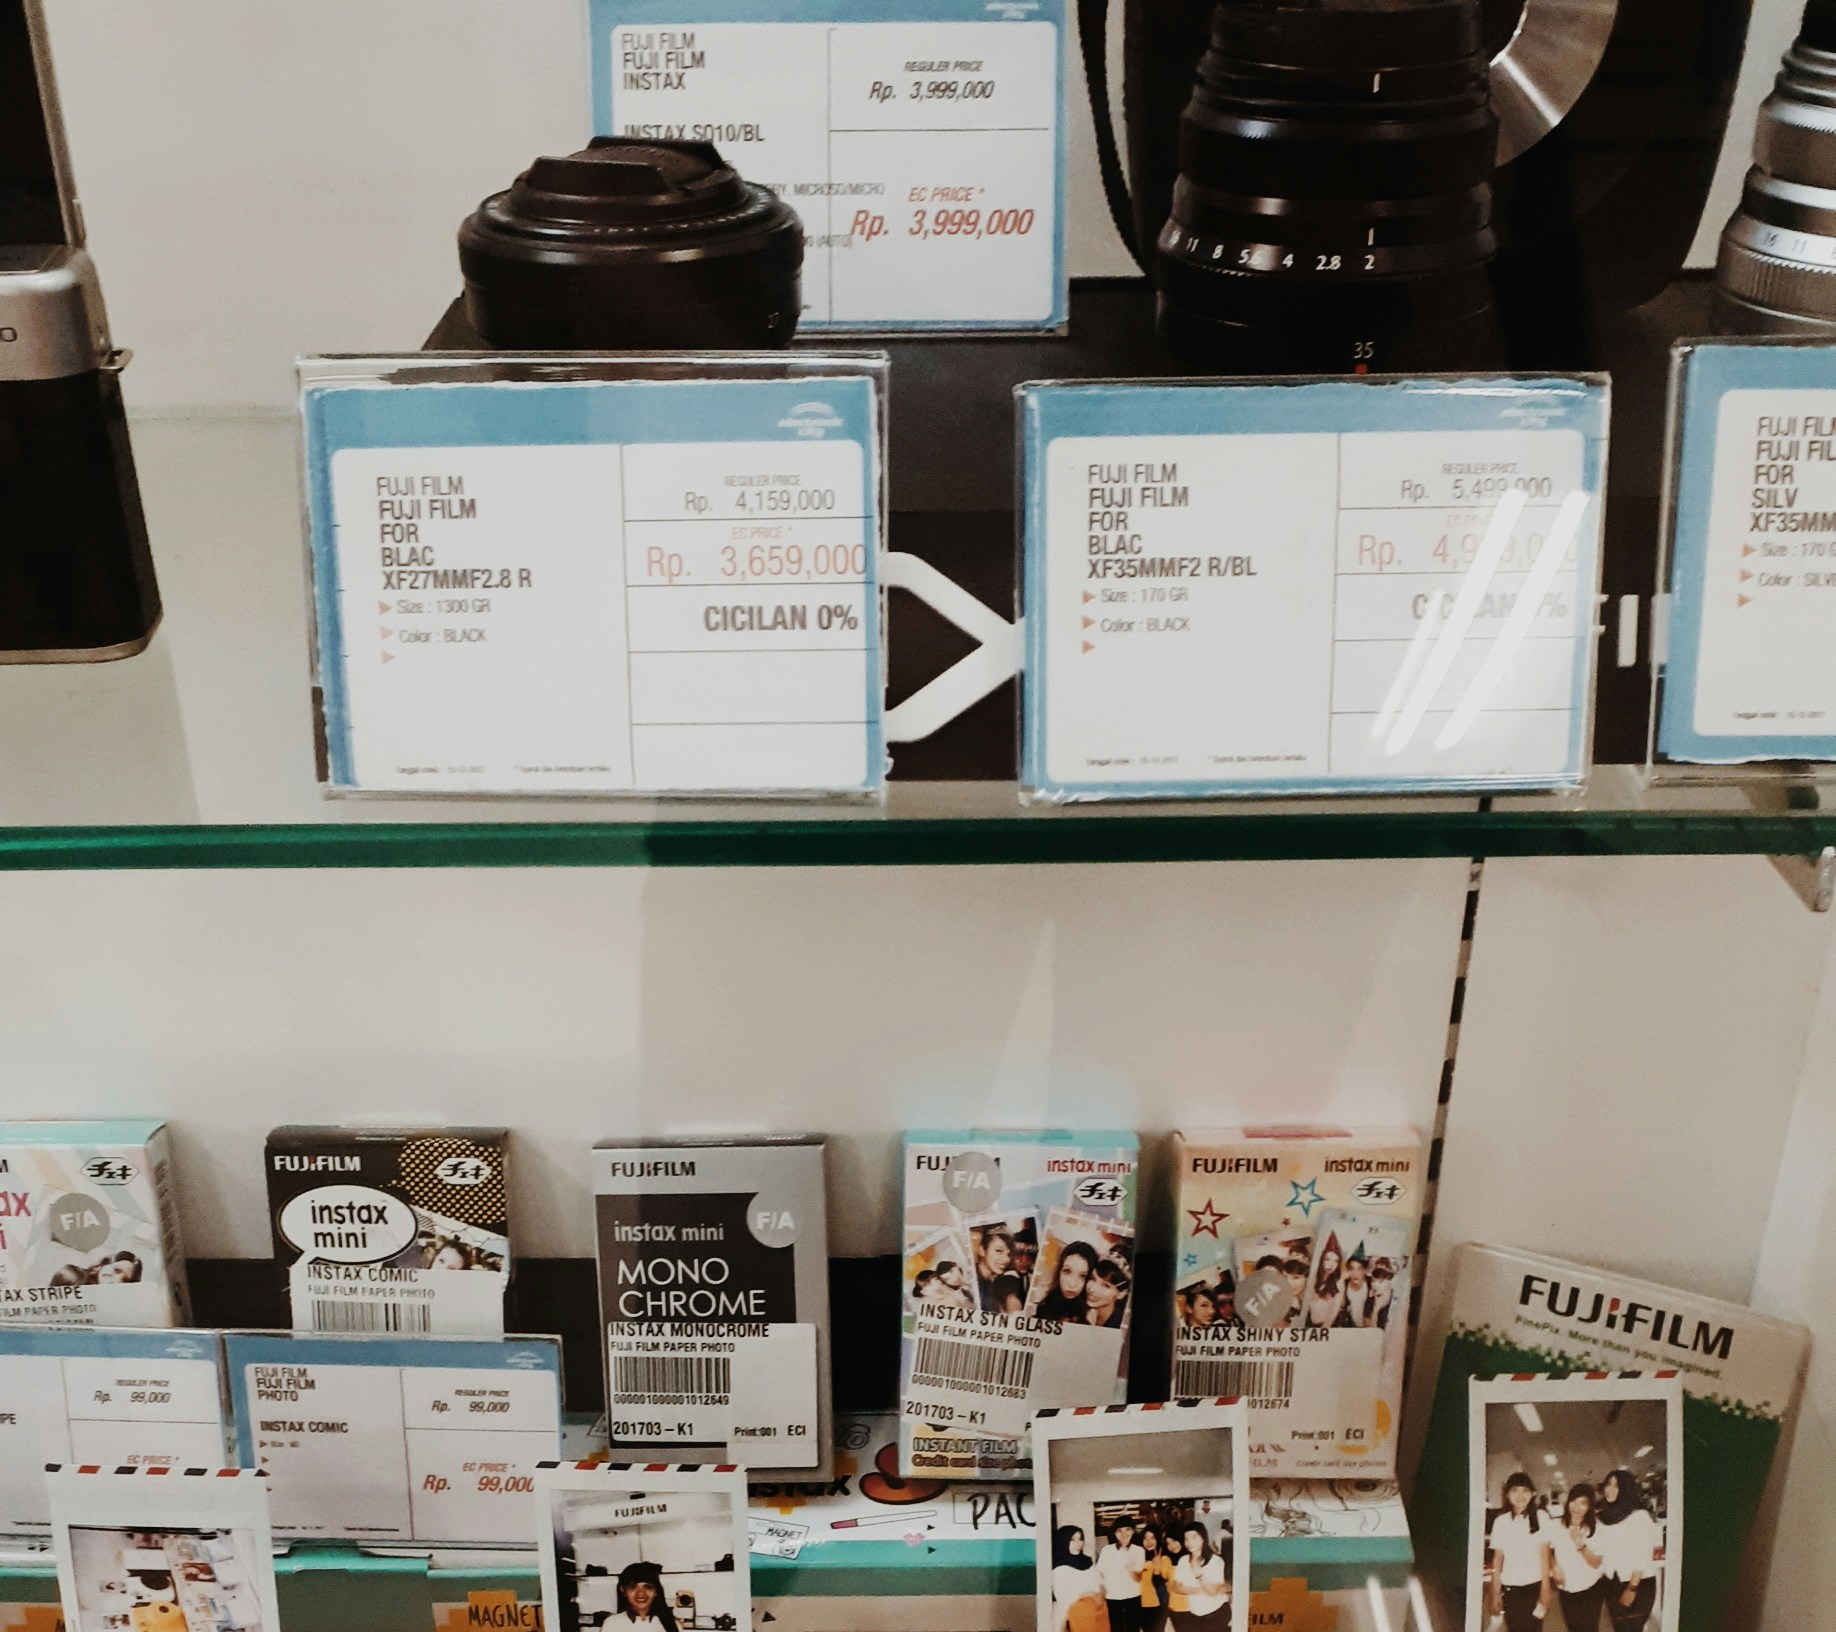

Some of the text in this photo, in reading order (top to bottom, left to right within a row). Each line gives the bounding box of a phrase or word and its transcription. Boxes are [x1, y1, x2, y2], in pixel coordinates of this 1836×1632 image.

[622, 32, 696, 51] FUJI FILM
[623, 51, 706, 70] FUJI FILM
[623, 72, 687, 90] INSTAX
[869, 81, 995, 101] Rp. 3,999,000
[909, 187, 973, 202] EC PRICE
[851, 209, 1035, 238] Rp. 3,999,000
[1354, 341, 1375, 359] 35
[1758, 416, 1797, 436] FUJI
[1756, 440, 1799, 461] FUJI
[1088, 463, 1178, 485] FUJI FILM
[1755, 464, 1794, 485] FOR
[376, 476, 464, 497] FUJI FILM
[685, 490, 835, 514] Rp. 4,159,000
[1088, 486, 1189, 509] FUJI FILM
[1752, 488, 1798, 509] SILV
[379, 499, 477, 521] FUJI FILM
[1088, 512, 1128, 532] FOR
[381, 524, 419, 544] FOR
[1088, 534, 1143, 556] BLAC
[381, 547, 434, 567] BLAC
[647, 544, 869, 582] Rp. 3,659,000
[1087, 556, 1258, 580] XF35MMF2 R/BL
[382, 570, 532, 591] XF27MMF2.8 R
[704, 605, 858, 632] CICILAN 0%
[1146, 617, 1190, 633] BLACK
[443, 627, 487, 642] BLACK
[274, 1155, 362, 1173] FUJIFILM
[611, 1161, 696, 1177] FUJIFILM
[1047, 1157, 1132, 1174] instax mini
[1192, 1157, 1278, 1174] FUJIFILM
[1324, 1156, 1410, 1174] instax mini
[953, 1173, 991, 1190] F/A
[311, 1199, 388, 1226] instax
[756, 1211, 796, 1231] F/A
[313, 1227, 368, 1249] mini
[614, 1220, 725, 1242] instax mini
[307, 1265, 419, 1283] INSTAX COMIC
[617, 1257, 730, 1285] MONO
[333, 1286, 358, 1298] FILM
[362, 1286, 397, 1299] PAPER
[400, 1287, 436, 1299] PHOTO
[1244, 1282, 1282, 1318] F/A
[618, 1289, 766, 1318] CHROME
[920, 1303, 1063, 1336] INSTAX STN GLASS
[1519, 1274, 1734, 1360] FUJIFILM
[610, 1322, 770, 1338] INSTAX MONOCROME
[918, 1321, 1042, 1349] FUJI FILM PAPER PHOTO
[1176, 1326, 1329, 1342] INSTAX SHINY STAR
[610, 1341, 735, 1353] FUJI FILM PAPER PHOTO
[1176, 1345, 1300, 1358] FUJI FILM PAPER PHOTO
[254, 1366, 308, 1378] FUJI FILM
[256, 1378, 316, 1390] FUJI FILM
[130, 1391, 171, 1406] 99,000
[258, 1389, 299, 1402] PHOTO
[431, 1400, 511, 1415] Rp. 99,000
[260, 1420, 349, 1435] INSTAX COMIC
[913, 1437, 1018, 1454] INSTANT FILM
[423, 1474, 451, 1493] Rp.
[468, 1604, 542, 1629] MAGNET
